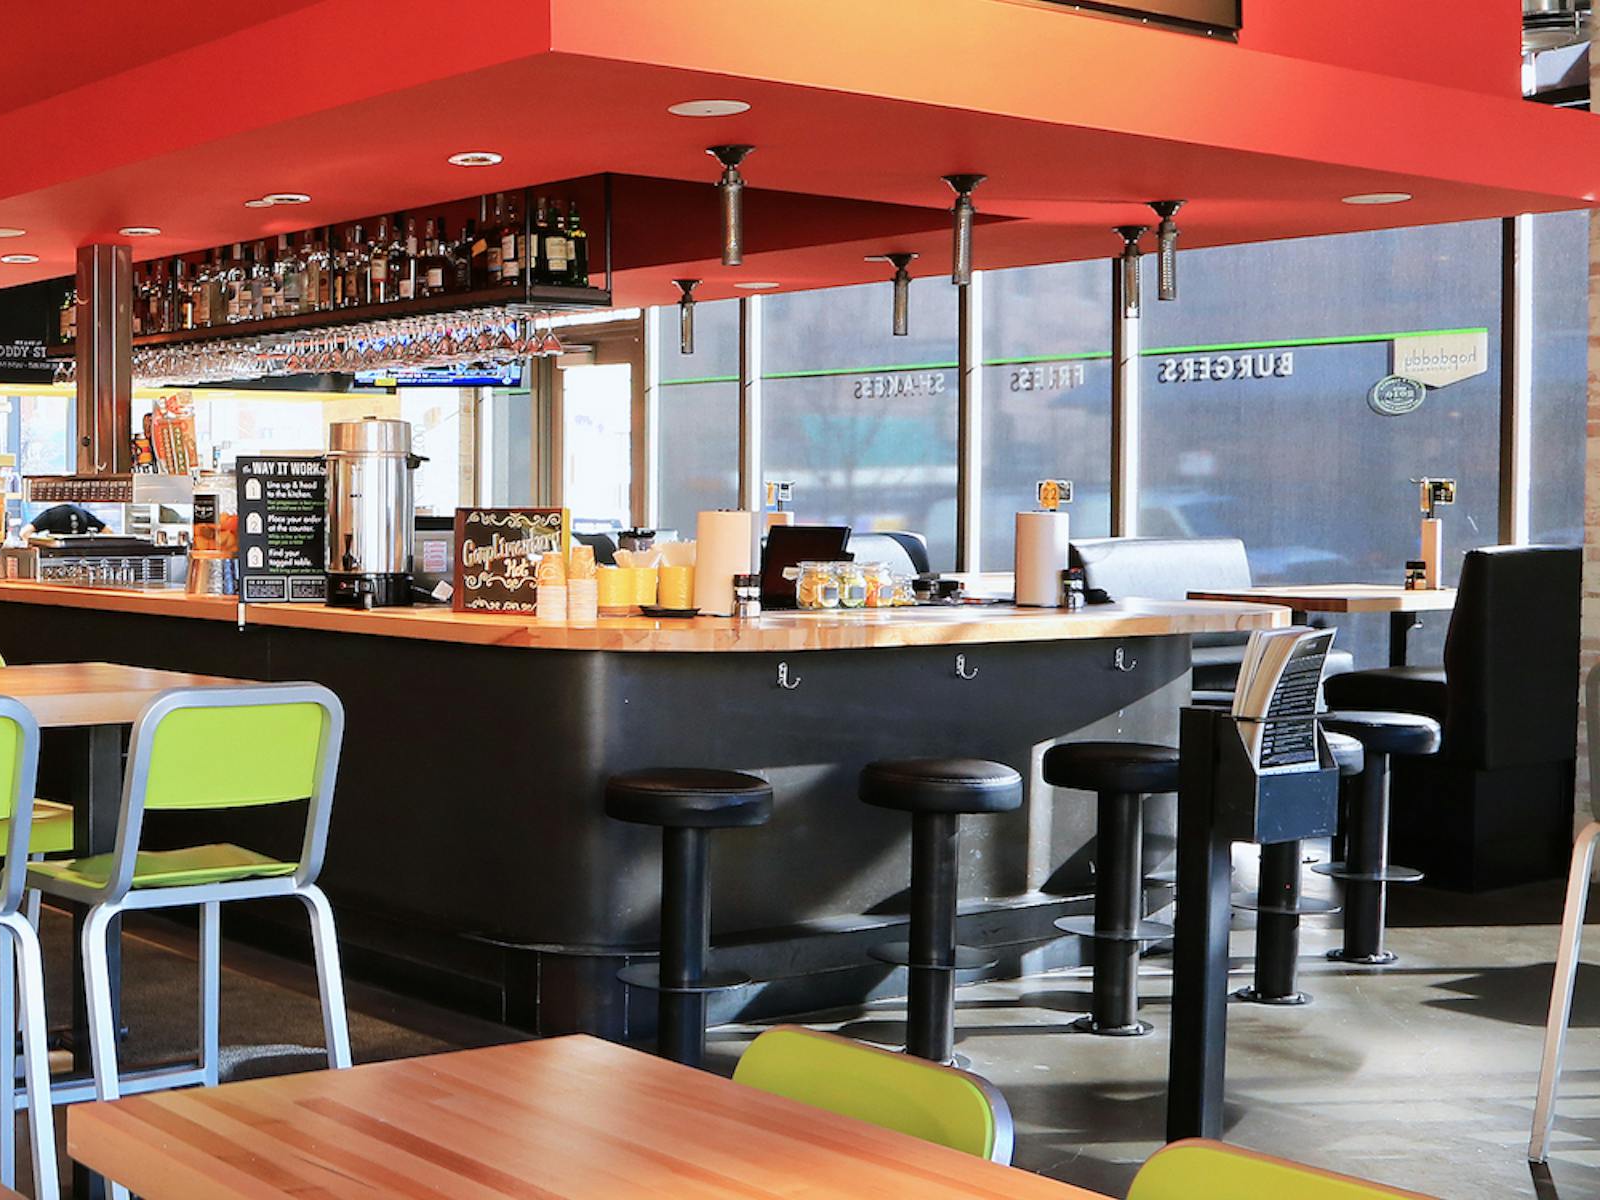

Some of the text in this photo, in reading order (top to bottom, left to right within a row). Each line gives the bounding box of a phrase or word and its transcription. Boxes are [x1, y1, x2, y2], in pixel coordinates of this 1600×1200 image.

[252, 462, 275, 475] WAY
[277, 462, 288, 475] IT
[267, 481, 280, 489] Line
[281, 482, 291, 490] up
[299, 481, 317, 489] head
[267, 490, 274, 498] to
[275, 489, 286, 498] the
[287, 516, 302, 525] your
[303, 515, 321, 523] order
[268, 548, 300, 559] Find your
[505, 558, 529, 578] Hot
